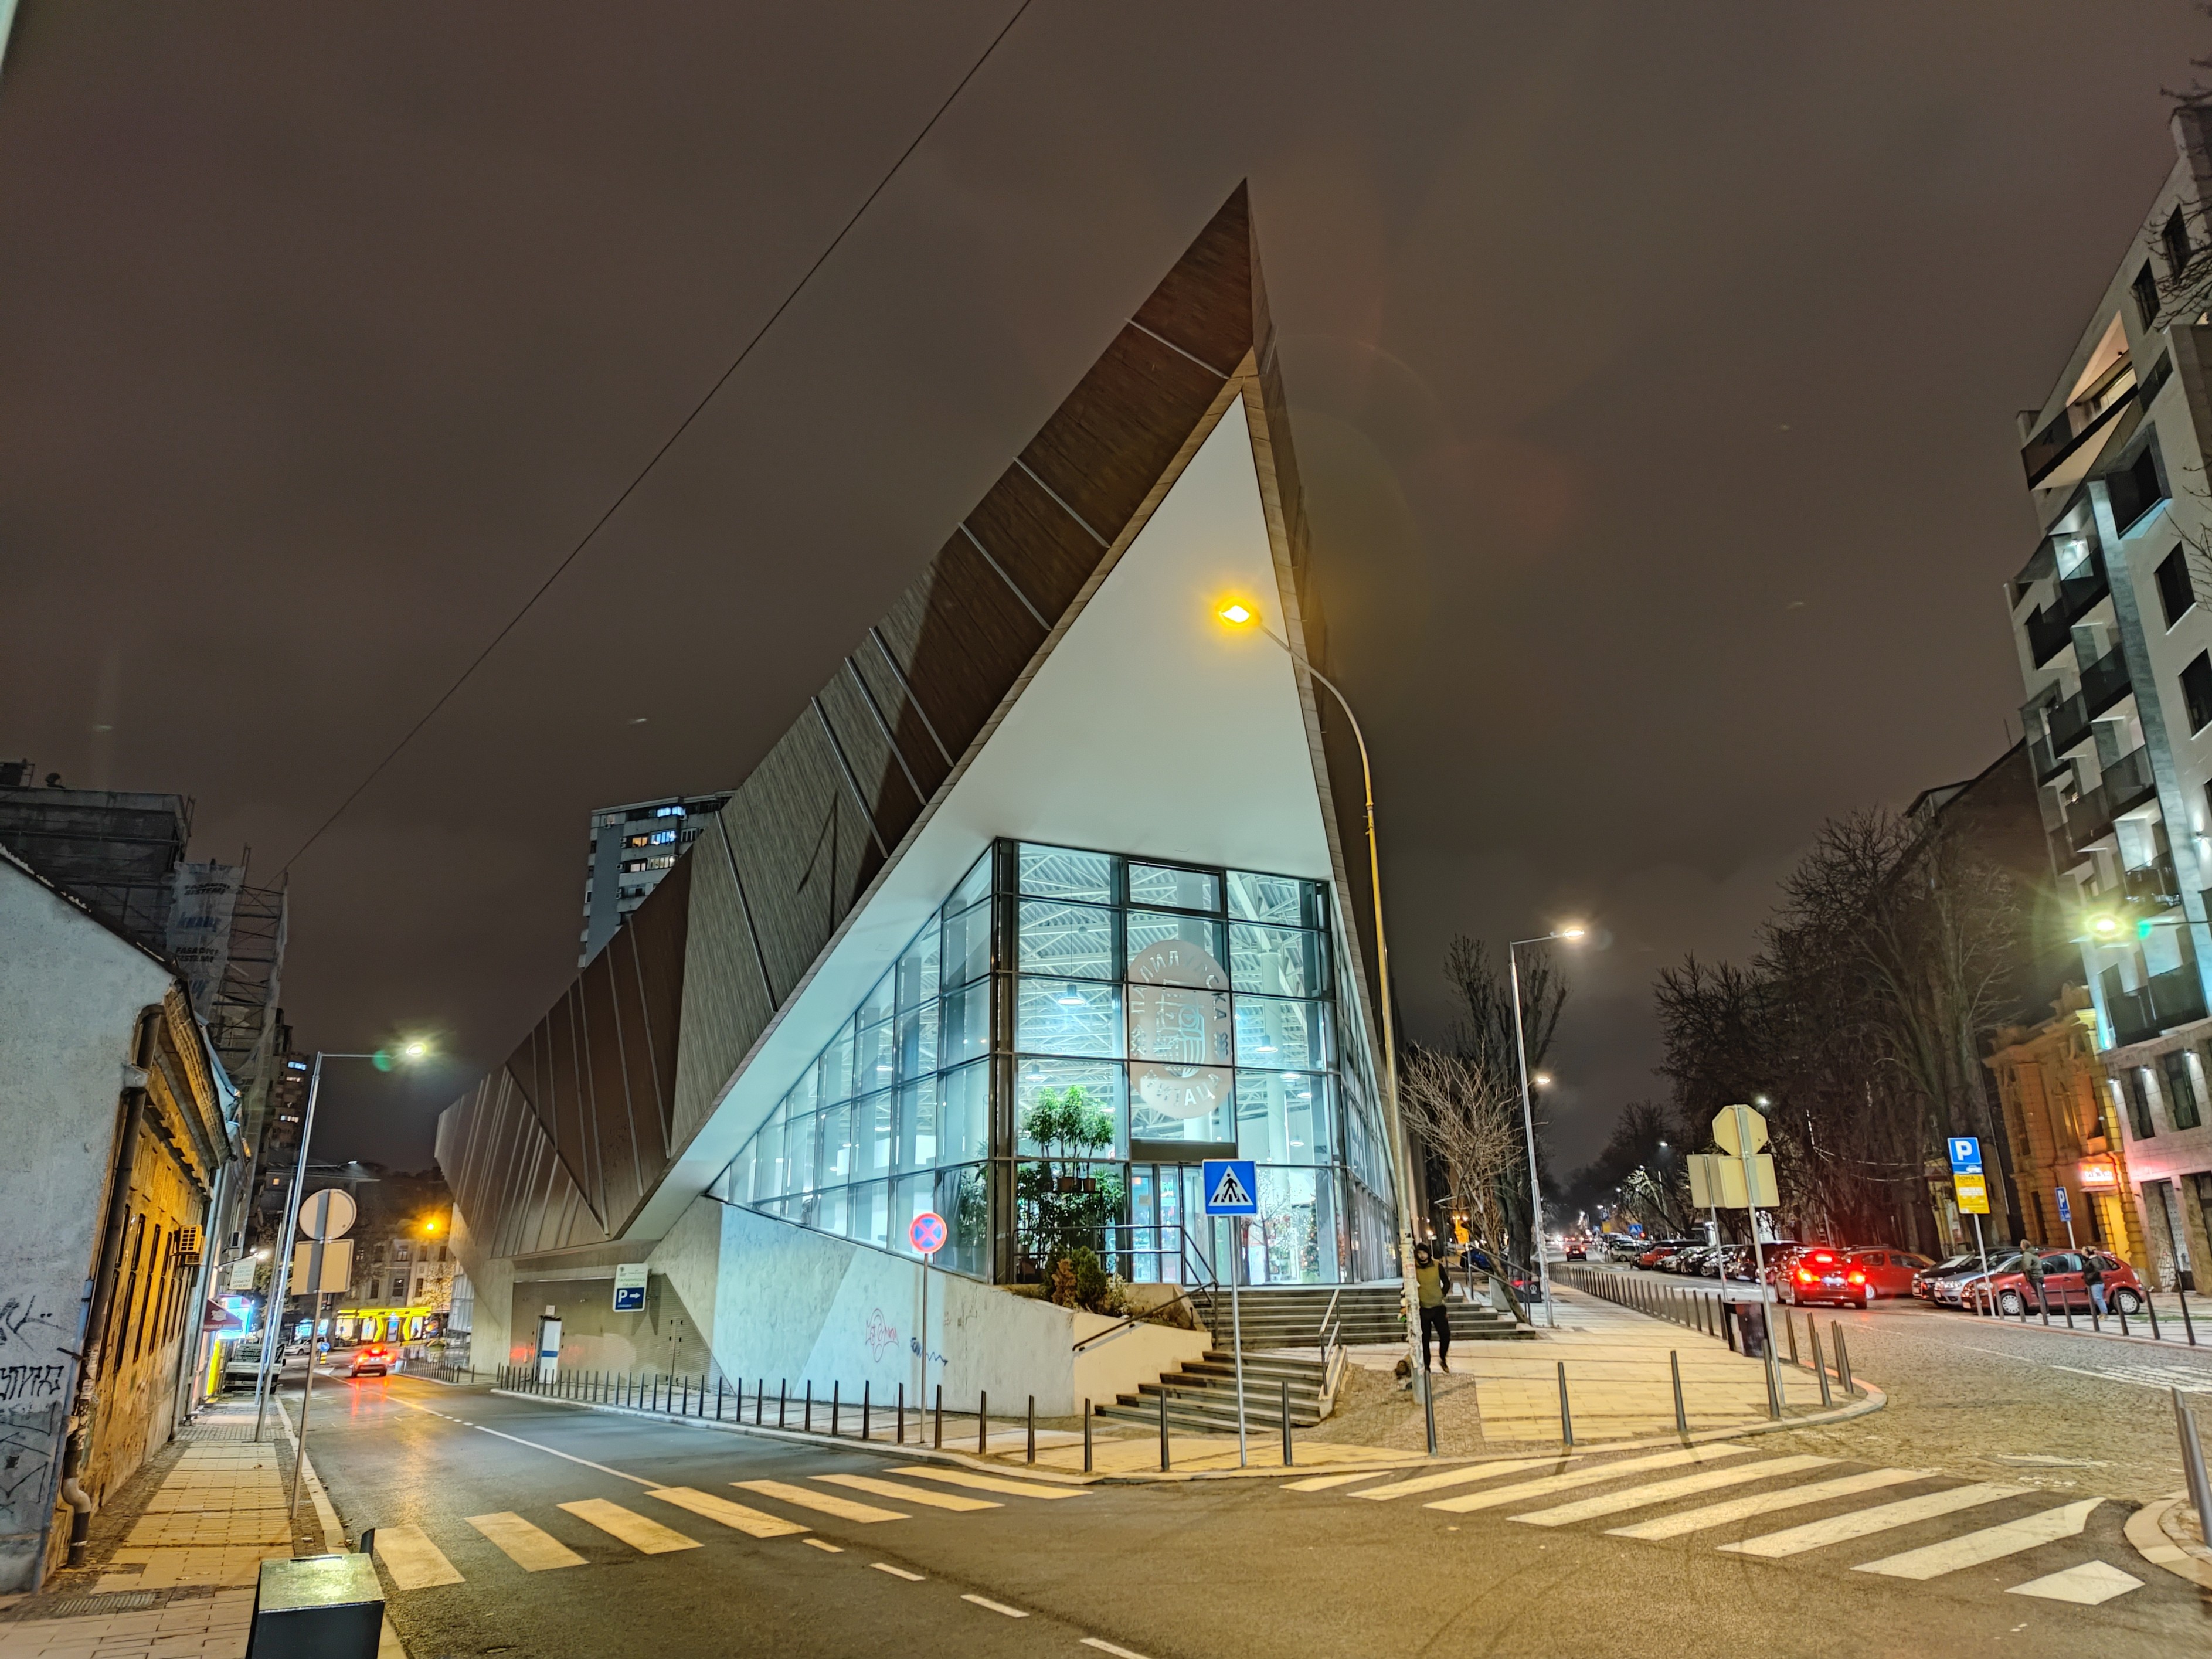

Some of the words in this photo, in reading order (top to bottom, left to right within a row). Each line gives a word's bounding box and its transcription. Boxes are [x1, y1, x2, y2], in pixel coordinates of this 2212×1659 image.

[1955, 1140, 1973, 1161] P
[2057, 1190, 2065, 1208] P
[618, 1290, 628, 1303] P
